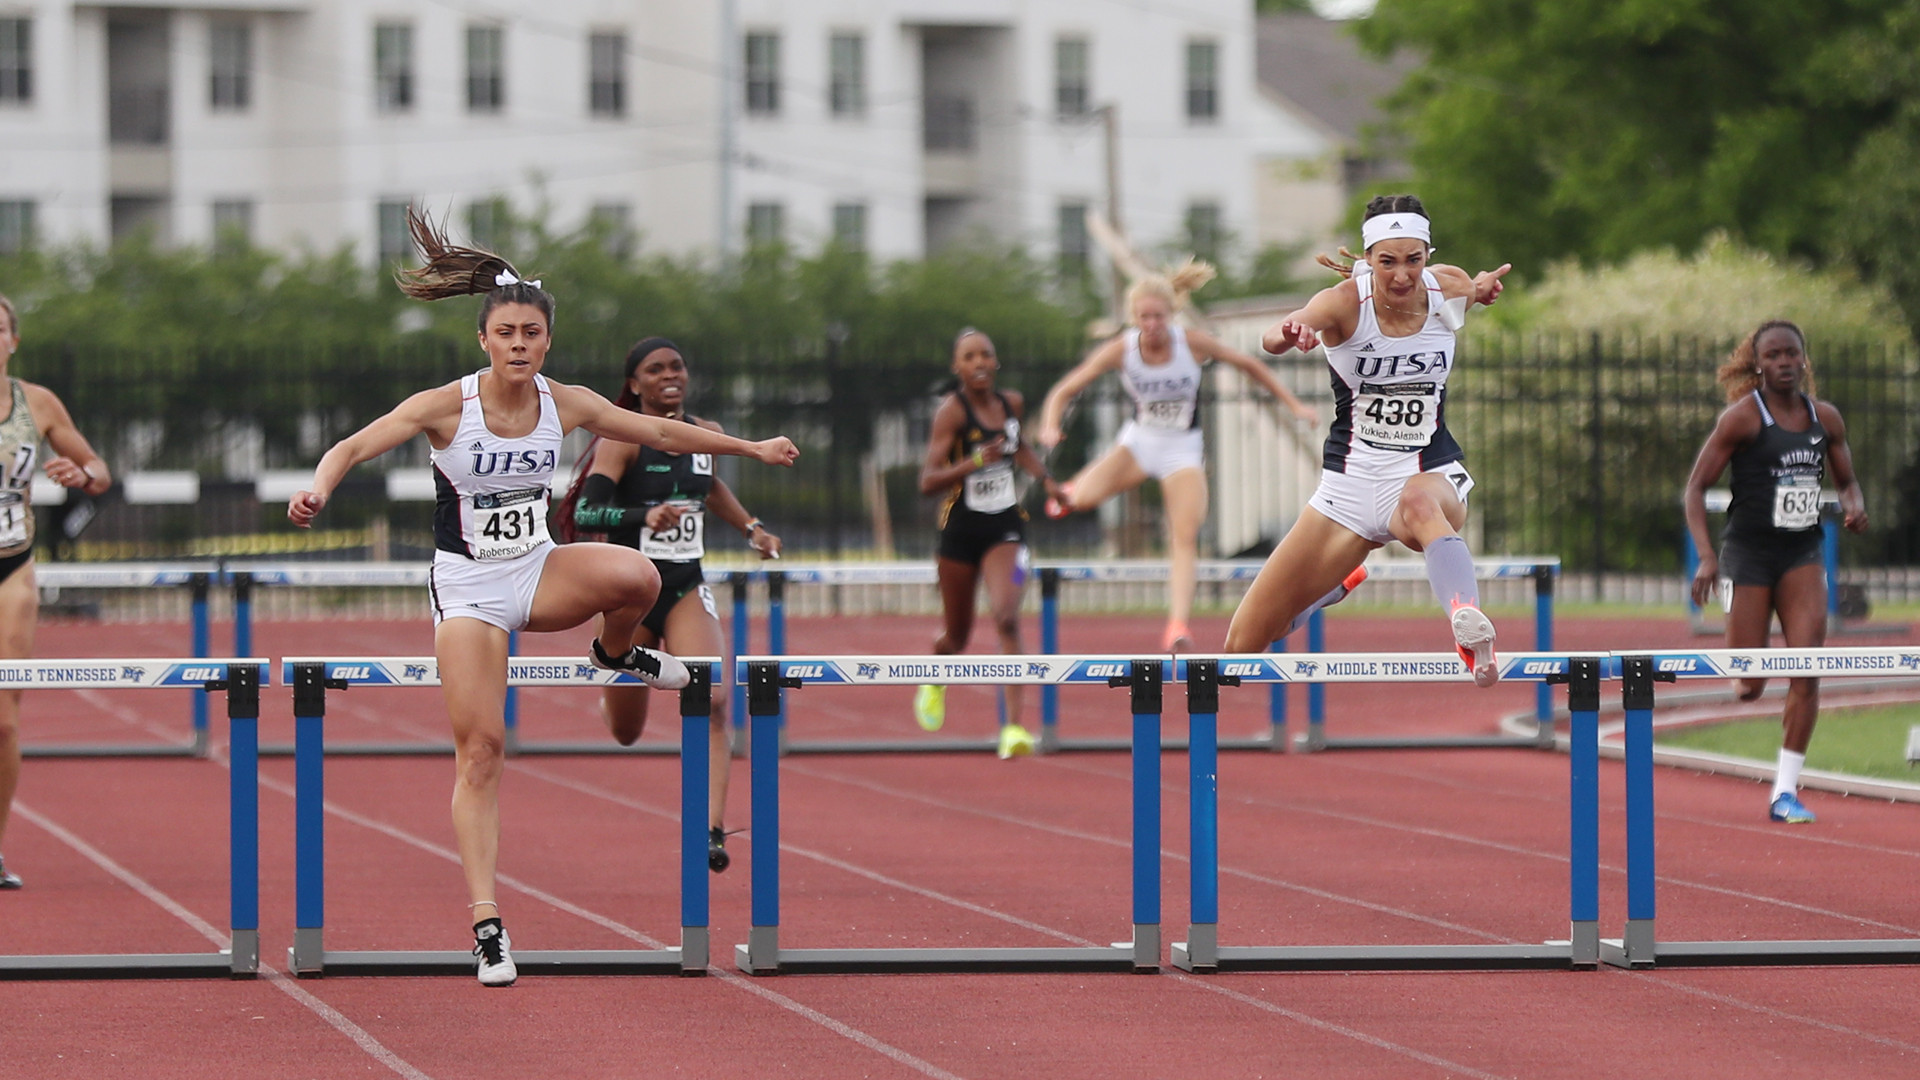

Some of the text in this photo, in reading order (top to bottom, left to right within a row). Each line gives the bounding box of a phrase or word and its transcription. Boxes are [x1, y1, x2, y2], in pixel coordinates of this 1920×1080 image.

[1354, 351, 1448, 378] UTSA
[1365, 398, 1424, 427] 438
[1360, 425, 1391, 440] Yukich,
[471, 450, 555, 477] UTSA
[483, 506, 535, 541] 431
[480, 545, 525, 559] Roberson,
[1224, 663, 1262, 676] GILL
[1327, 662, 1459, 675] MIDDLE TENNESSEE
[1523, 661, 1562, 675] GILL
[1658, 658, 1697, 672] GILL
[1761, 656, 1894, 670] MIDDLE TENNESSEE
[37, 668, 116, 682] TENNESSEE
[182, 668, 221, 681] GILL
[331, 667, 370, 679] GILL
[508, 666, 570, 680] NNESSEE
[785, 665, 824, 678] GILL
[889, 664, 1022, 678] MIDDLE TENNESSEE
[1086, 664, 1125, 677] GILL
